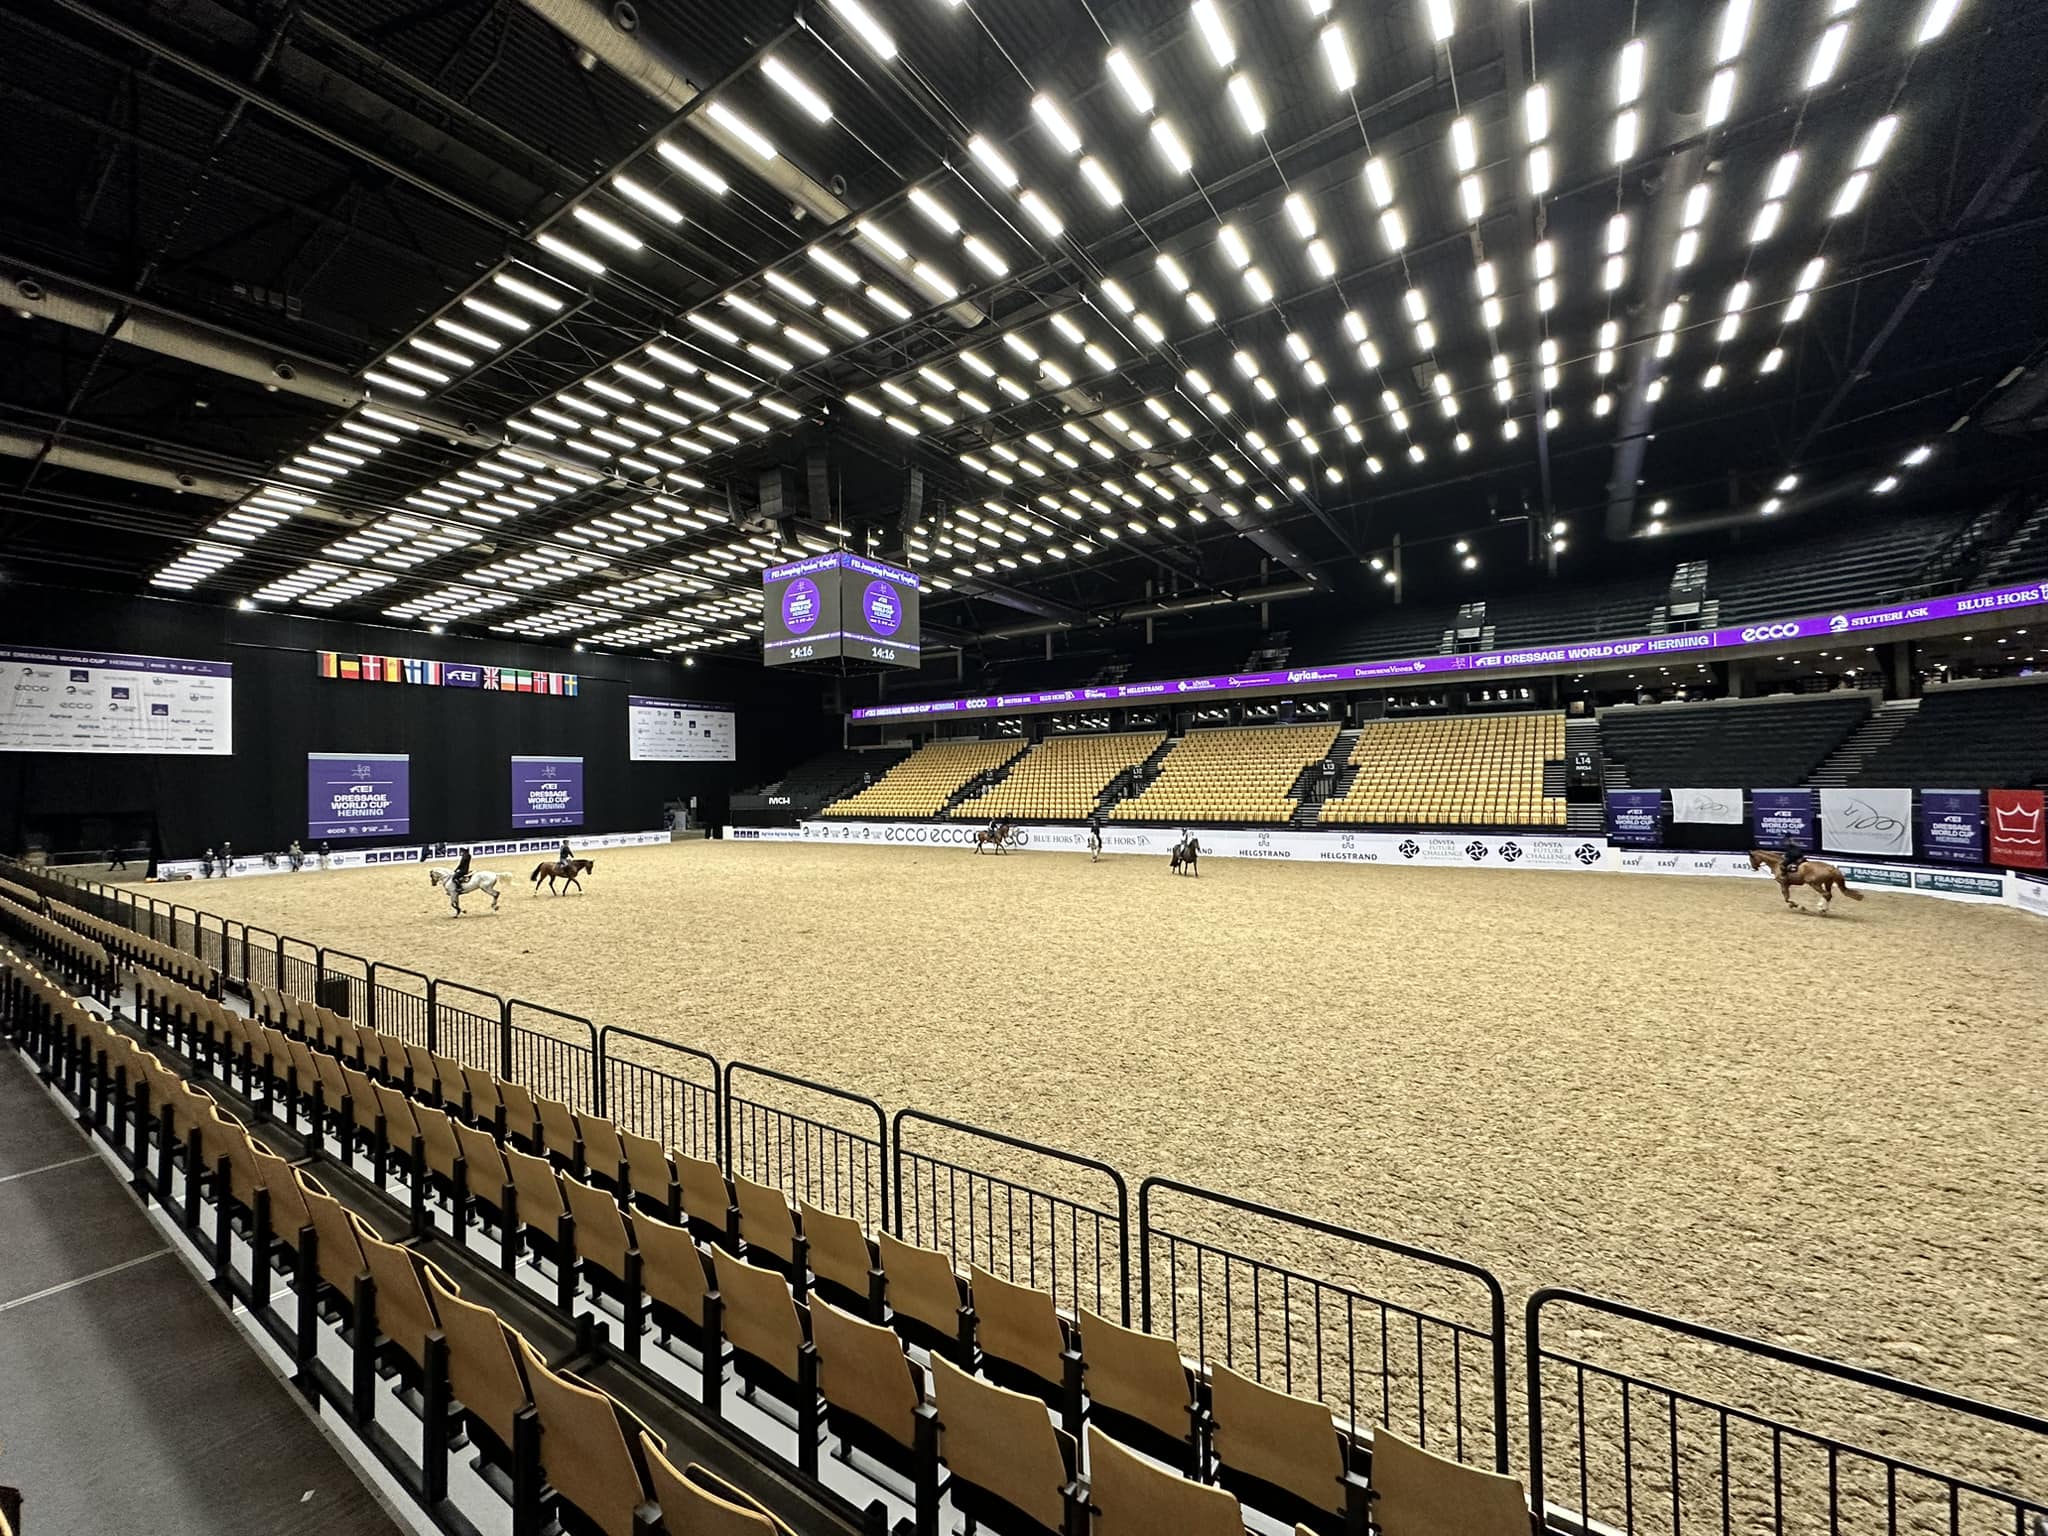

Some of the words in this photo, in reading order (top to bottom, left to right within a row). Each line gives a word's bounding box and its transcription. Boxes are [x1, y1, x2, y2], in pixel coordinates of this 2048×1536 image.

[1957, 595, 1994, 611] BLUE
[1997, 590, 2039, 606] HORS
[1851, 612, 1903, 626] STUTTERI
[1904, 608, 1928, 619] ASK
[1742, 622, 1799, 642] ecco
[790, 646, 813, 658] 14:16
[872, 647, 894, 659] 14:16
[1504, 650, 1565, 664] DRESSAGE
[1568, 646, 1613, 659] WORLD
[1648, 636, 1709, 650] HERNING
[1288, 671, 1311, 683] Agria
[1053, 835, 1072, 844] HORS
[1114, 837, 1136, 845] HORS
[1321, 852, 1377, 861] HELGSTRAND
